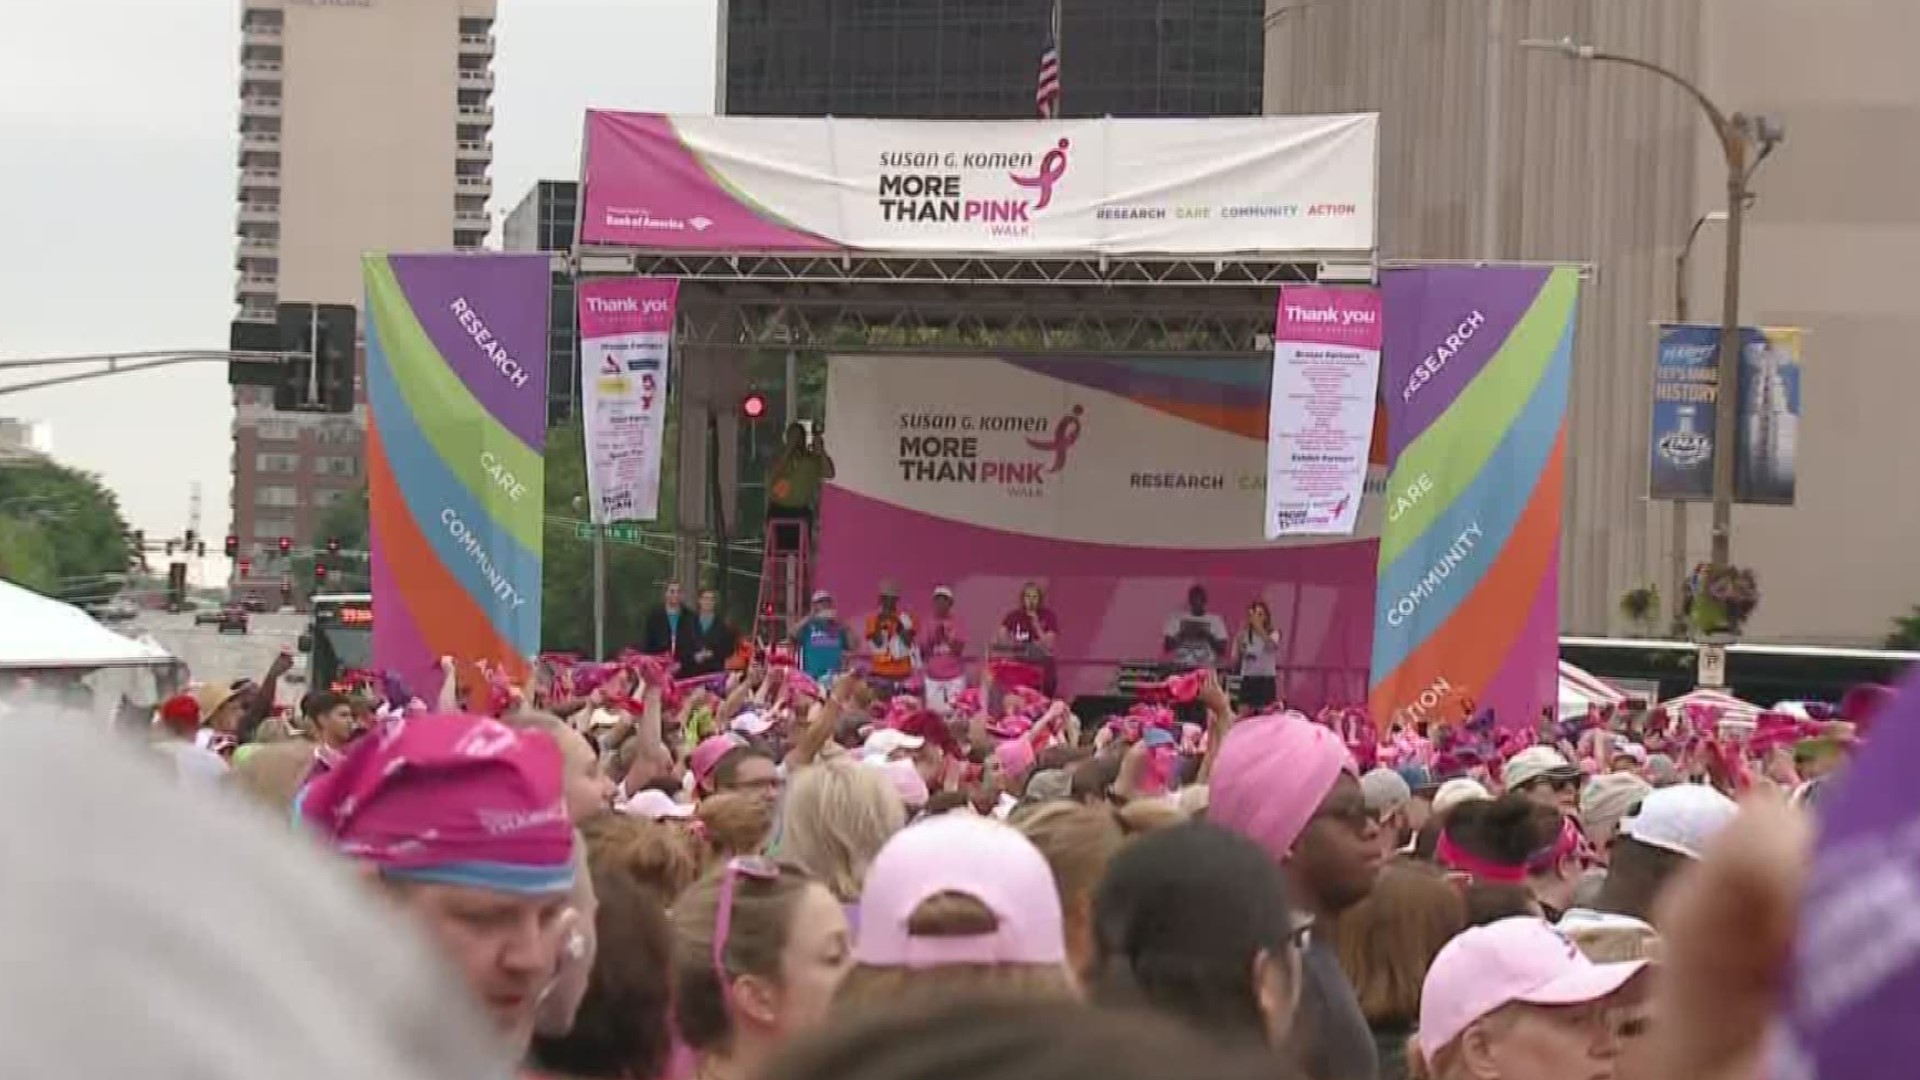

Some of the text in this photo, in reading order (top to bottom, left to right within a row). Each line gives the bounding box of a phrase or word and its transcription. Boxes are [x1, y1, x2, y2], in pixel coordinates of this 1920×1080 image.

[879, 174, 961, 197] MORE
[606, 215, 631, 226] Bank
[644, 217, 684, 229] America
[879, 199, 1028, 222] THAN PINK
[1096, 203, 1356, 220] RESEARCH CARE COMMUNITY ACTION
[991, 225, 1029, 236] WALK
[585, 297, 638, 312] Thank
[1285, 305, 1376, 325] Thank you
[450, 297, 530, 388] RESEARCH
[1657, 383, 1718, 402] HISTORY
[900, 436, 978, 458] MORE
[481, 451, 526, 501] CARE
[899, 459, 1044, 484] THAN PINK
[1130, 472, 1224, 490] RESEARCH
[1238, 475, 1266, 490] CA
[1388, 472, 1433, 523] CARE
[441, 508, 526, 610] COMMUNITY
[1387, 522, 1484, 627] COMMUNITY
[1407, 676, 1451, 722] TION
